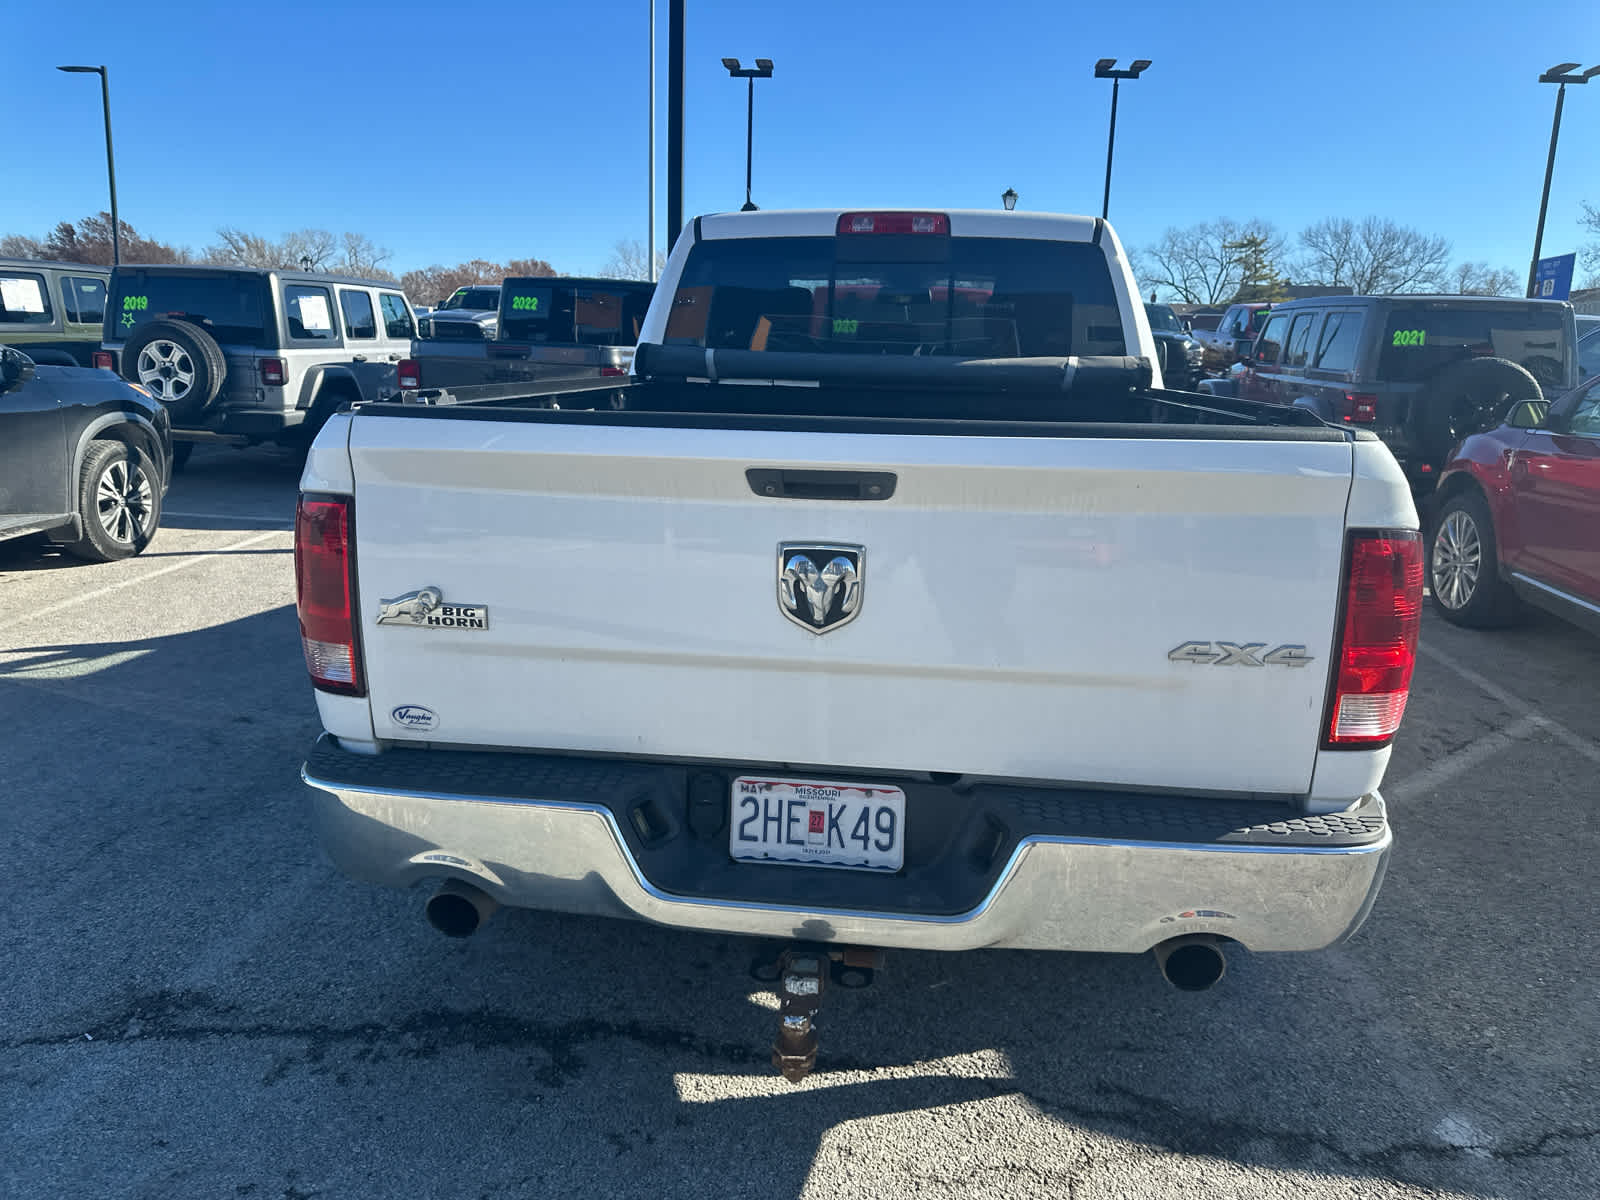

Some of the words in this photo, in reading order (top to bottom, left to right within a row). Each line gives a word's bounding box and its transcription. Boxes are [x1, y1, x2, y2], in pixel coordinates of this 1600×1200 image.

[123, 296, 148, 310] 2019
[512, 296, 538, 310] 2022
[1393, 329, 1425, 346] 2021
[442, 607, 476, 618] BIG
[427, 616, 483, 628] HORN
[740, 783, 764, 794] MAY
[795, 787, 841, 798] MISSOURI
[738, 796, 806, 846] 2HE
[827, 803, 897, 852] K49
[811, 815, 822, 826] 27
